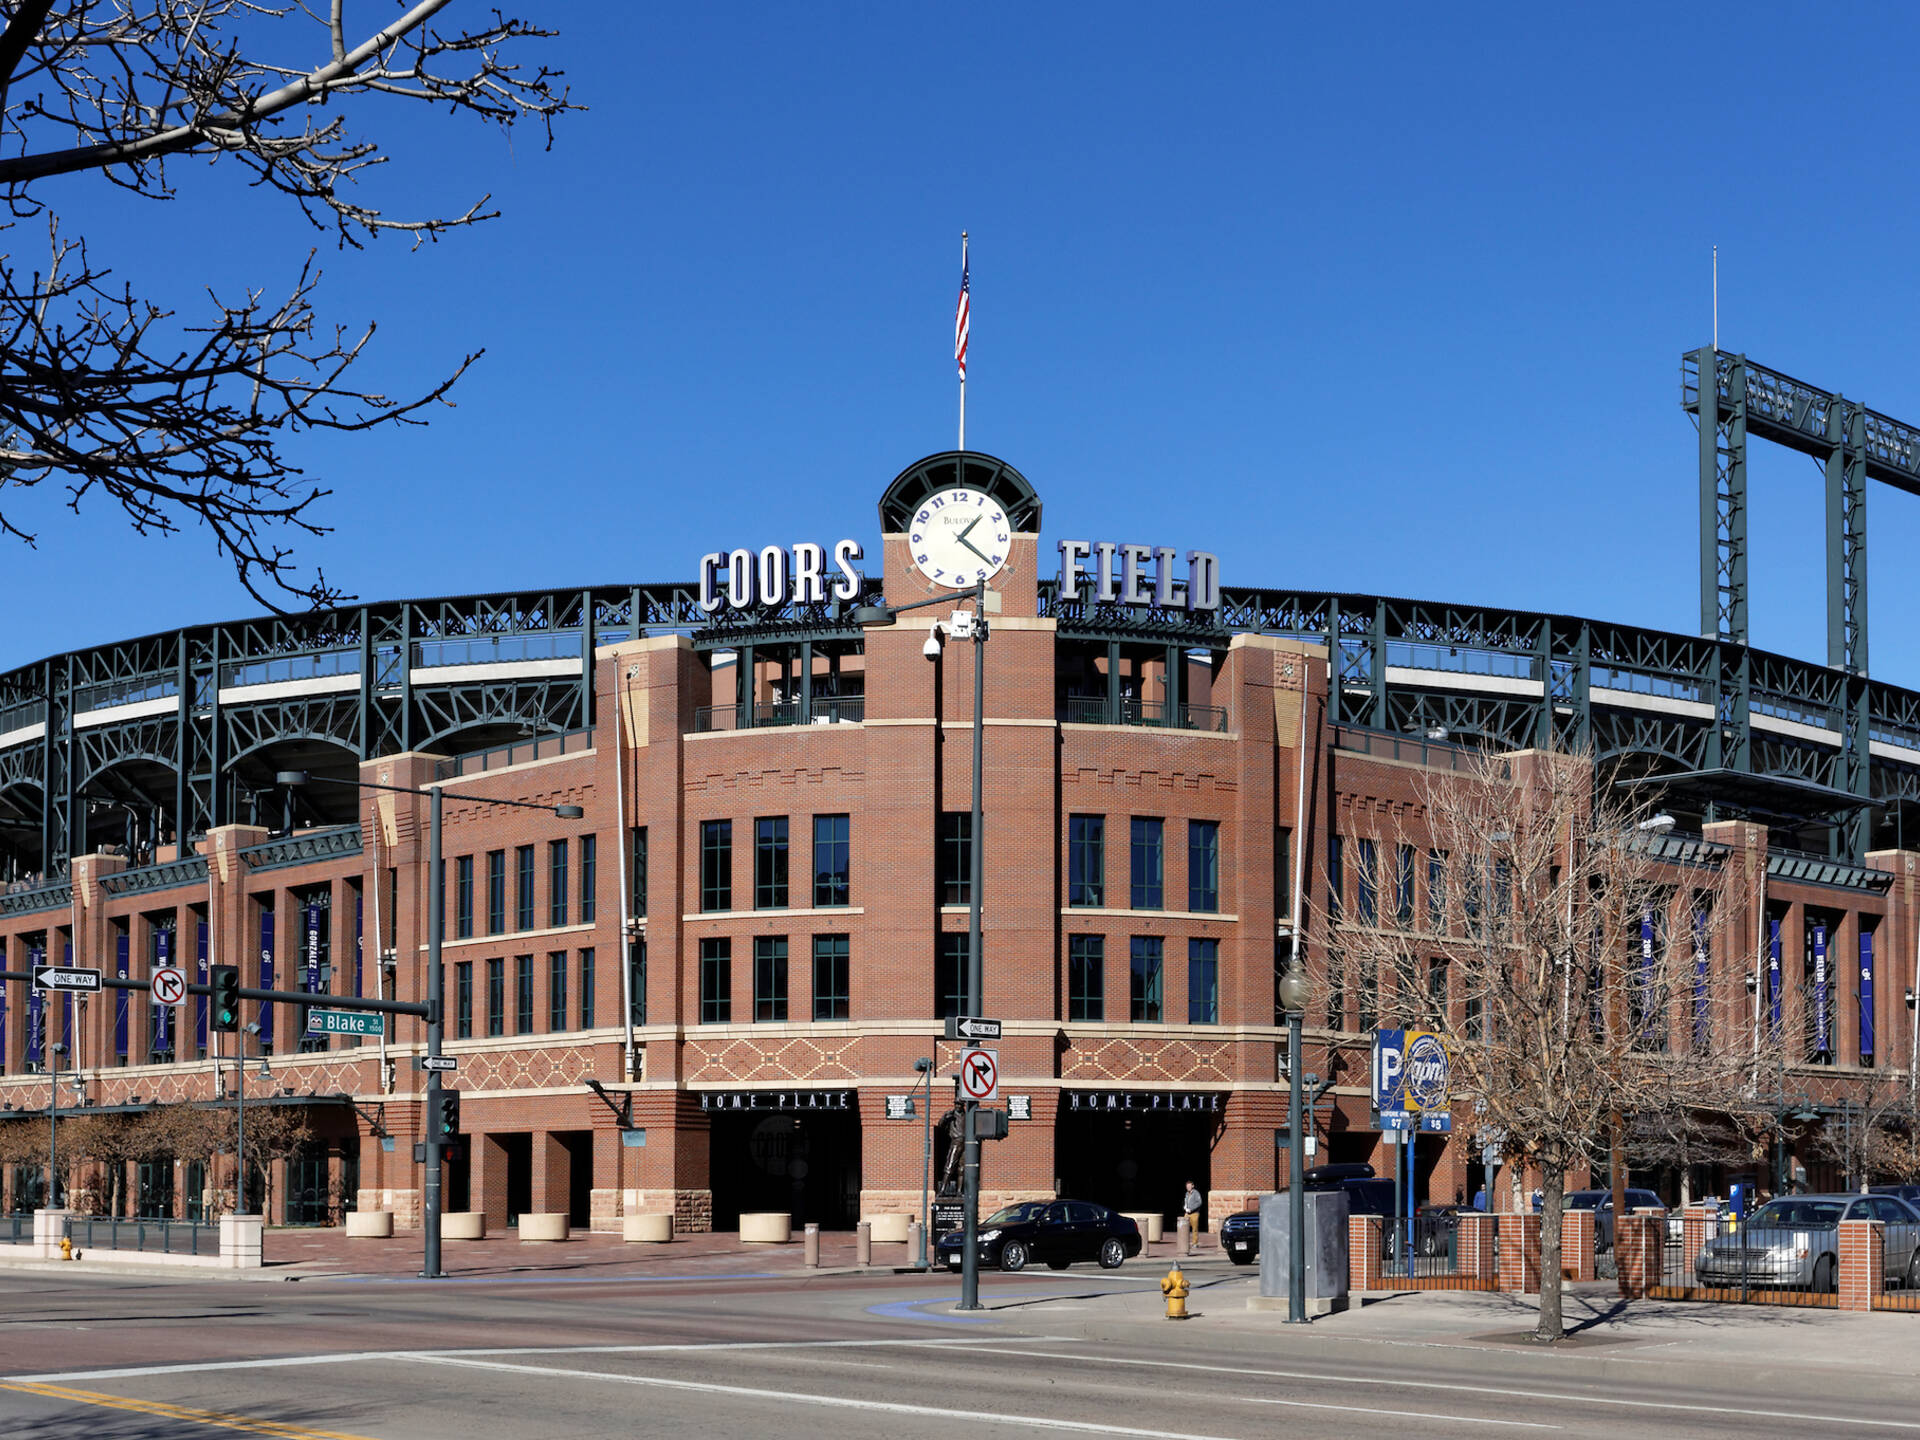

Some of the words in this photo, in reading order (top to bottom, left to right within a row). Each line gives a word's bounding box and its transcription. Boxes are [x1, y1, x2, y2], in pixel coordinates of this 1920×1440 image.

[931, 496, 945, 509] 11
[952, 492, 968, 502] 12
[977, 497, 985, 507] 1
[916, 510, 930, 525] 10
[991, 512, 1002, 523] 2
[912, 533, 923, 543] 9
[998, 533, 1007, 543] 3
[917, 554, 928, 565] 8
[991, 554, 1002, 565] 4
[700, 540, 864, 612] COORS
[1058, 540, 1220, 612] FIELD
[933, 568, 945, 579] 7
[976, 568, 987, 579] 5
[955, 575, 965, 585] 6
[309, 930, 318, 970] GONZALEZ
[54, 974, 72, 984] ONE
[75, 976, 94, 985] WAY
[327, 1015, 365, 1032] Blake
[970, 1024, 982, 1033] ONE
[984, 1025, 997, 1033] WAY
[1381, 1048, 1402, 1090] P
[702, 1094, 756, 1108] HOME
[779, 1093, 846, 1107] PLATE
[1072, 1094, 1131, 1108] HOME
[1153, 1095, 1218, 1108] PLATE
[1391, 1118, 1402, 1129] $7
[1431, 1119, 1441, 1130] $5
